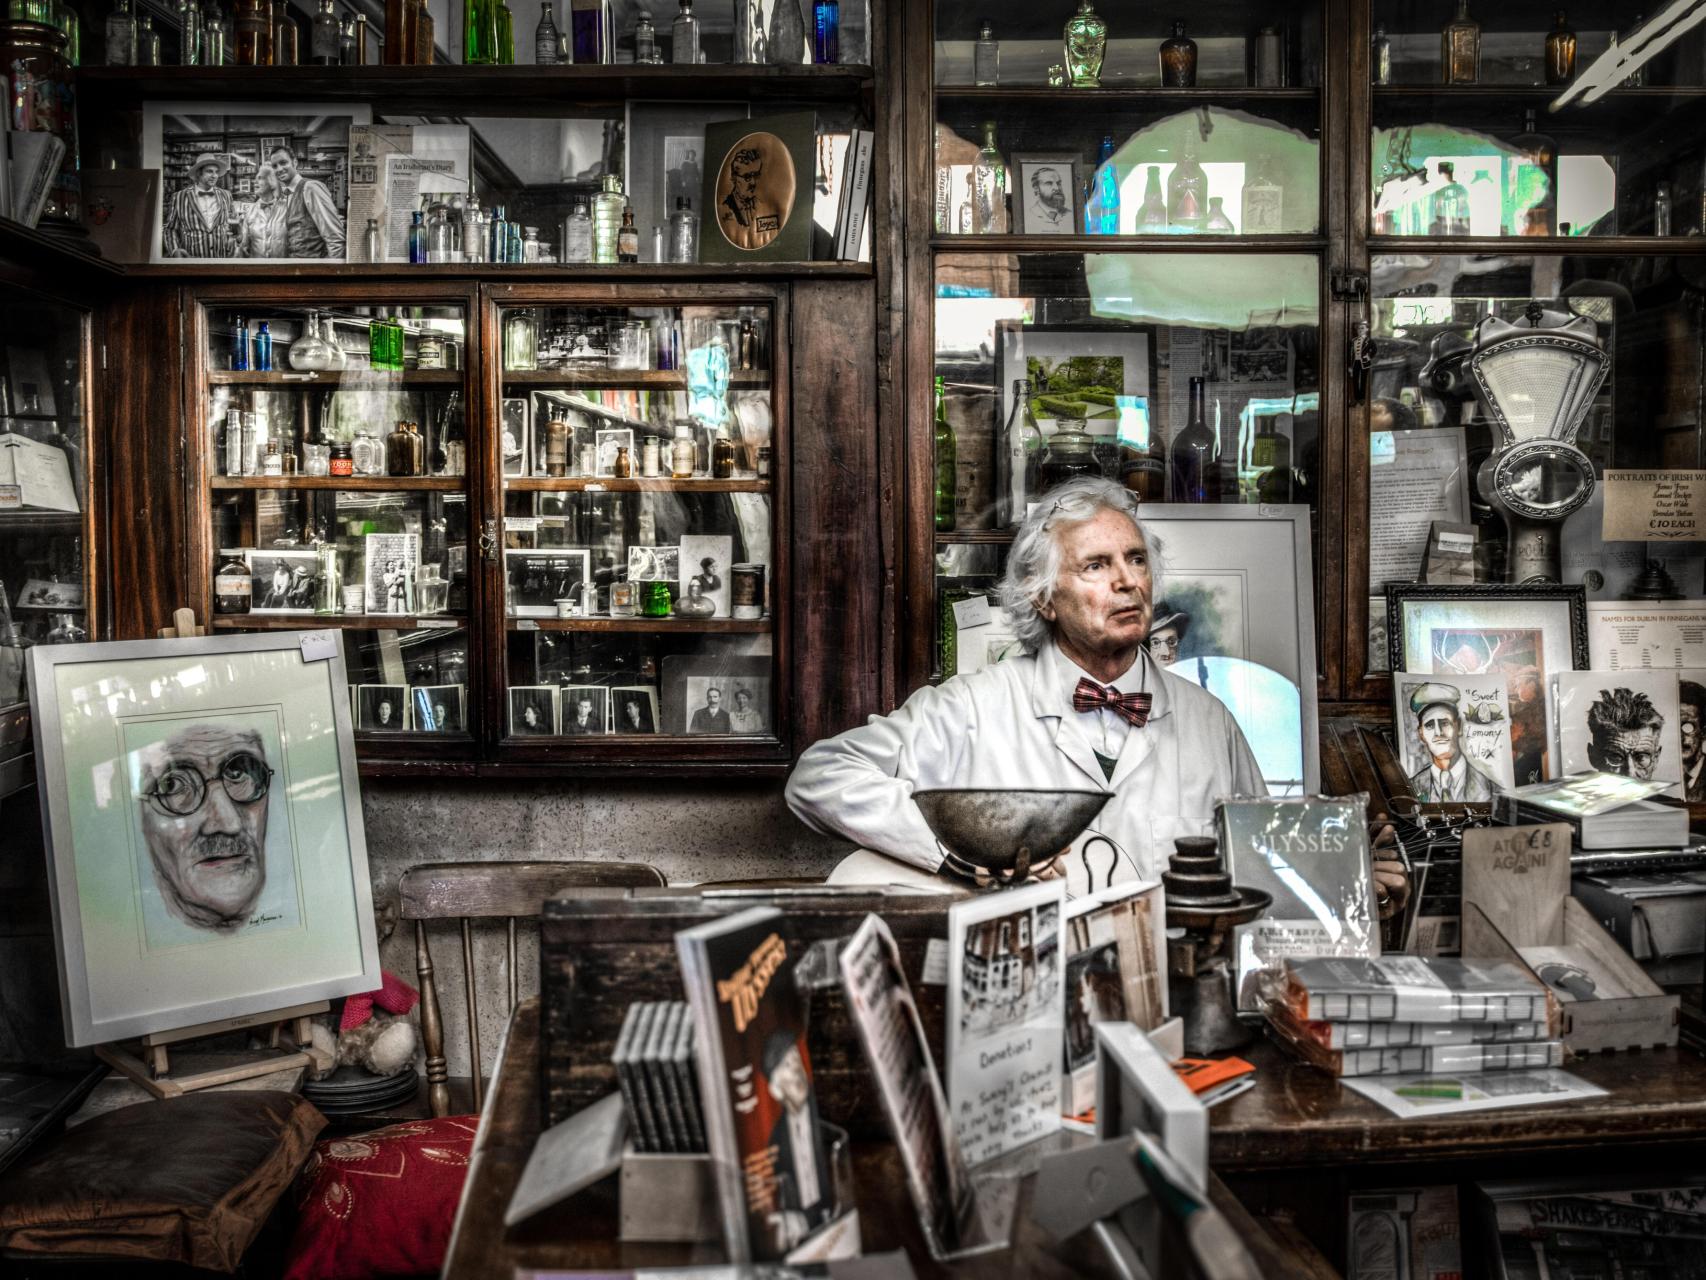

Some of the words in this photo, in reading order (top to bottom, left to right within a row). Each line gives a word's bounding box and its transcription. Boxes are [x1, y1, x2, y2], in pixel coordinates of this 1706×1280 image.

[1608, 473, 1657, 481] PORTRAITS
[1659, 473, 1670, 481] OF
[1672, 473, 1693, 481] IRISH
[1656, 500, 1672, 508] Oscar
[1671, 519, 1696, 528] EACH
[1251, 833, 1345, 854] ULYSSES
